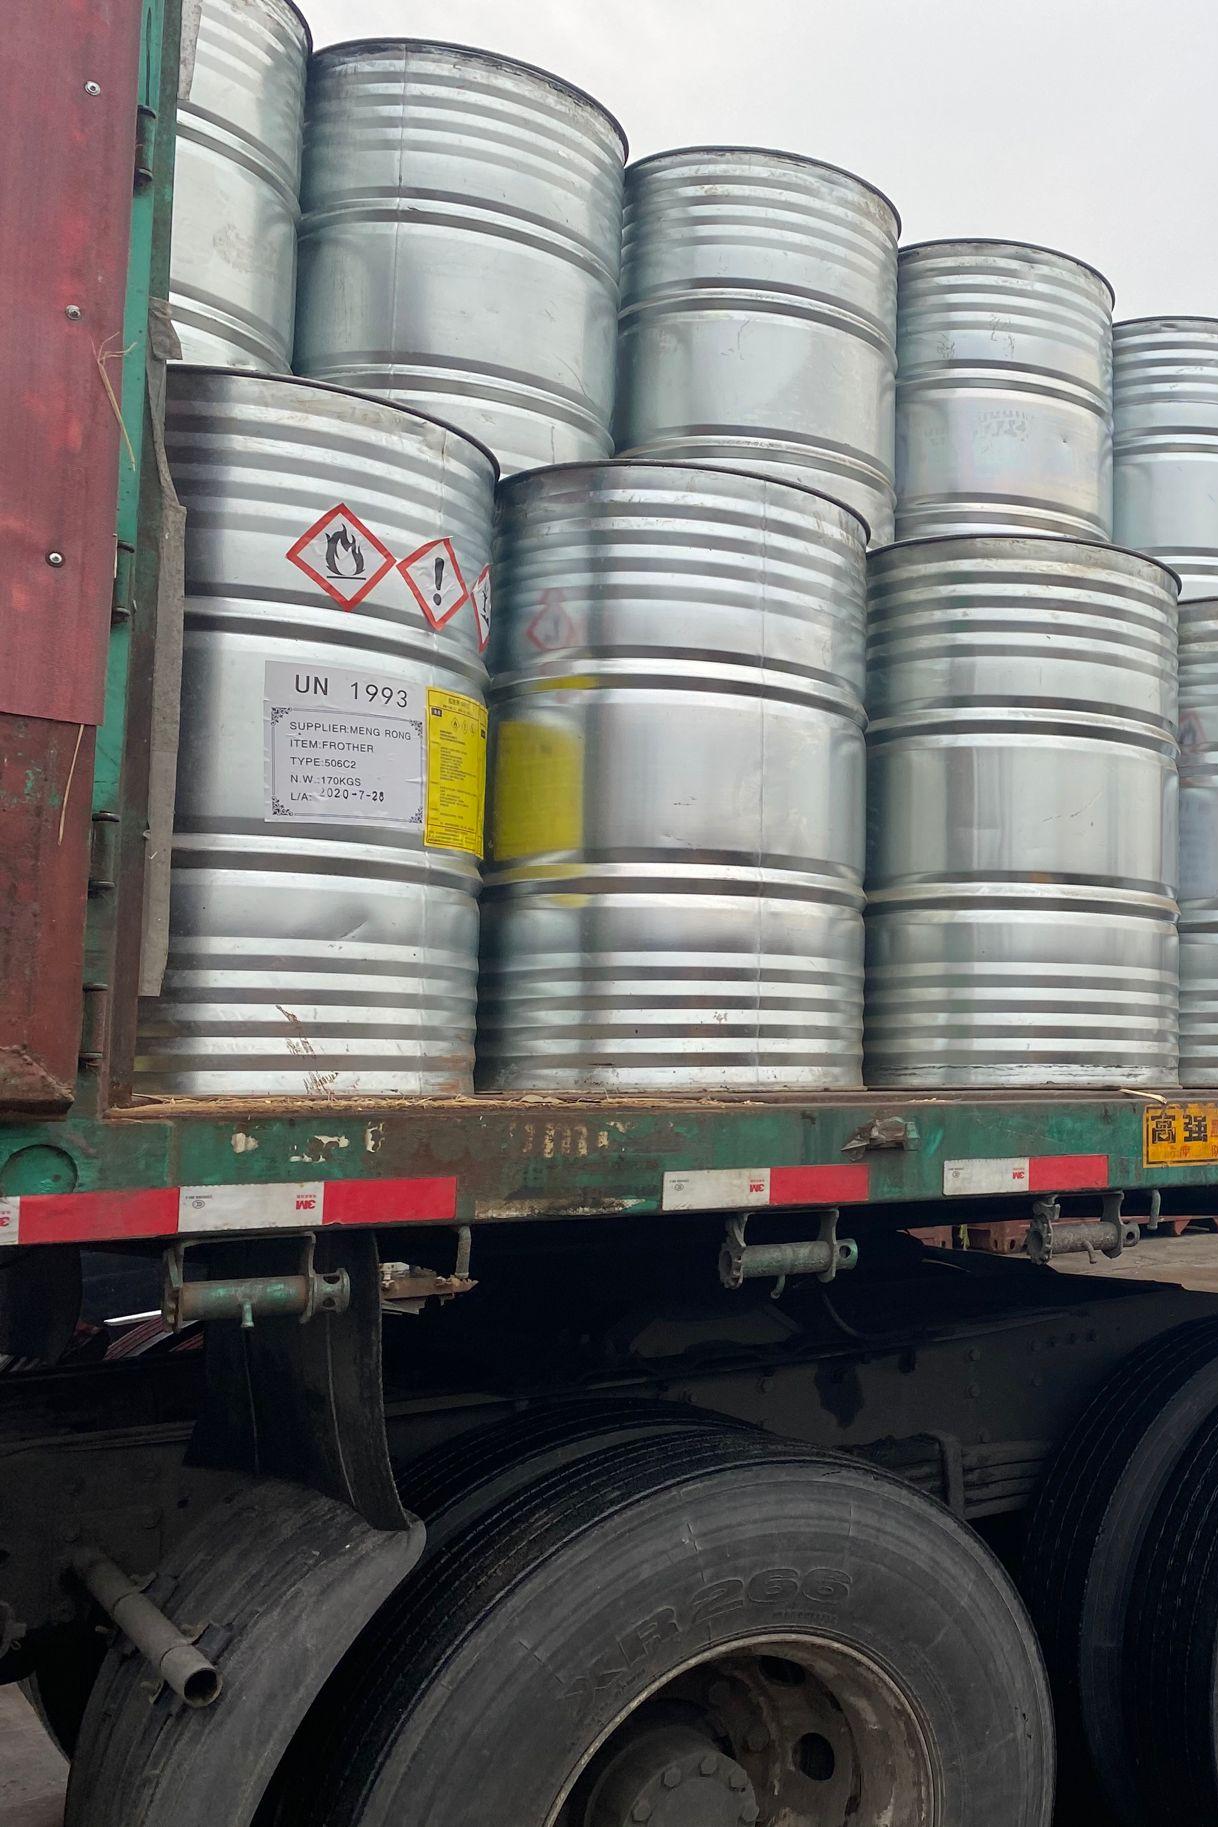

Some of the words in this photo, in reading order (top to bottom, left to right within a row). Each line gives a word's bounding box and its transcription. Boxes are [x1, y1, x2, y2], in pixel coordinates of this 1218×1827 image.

[295, 674, 328, 696] UN
[350, 682, 408, 708] 1993
[289, 721, 381, 737] SUPPLIER:MENG
[384, 729, 412, 741] RONG
[289, 738, 375, 753] ITEM:FROTHER
[289, 756, 357, 769] TYPE:506C2
[319, 787, 386, 803] 2020-7-28
[749, 1183, 765, 1192] 3M
[295, 1199, 316, 1210] 3M
